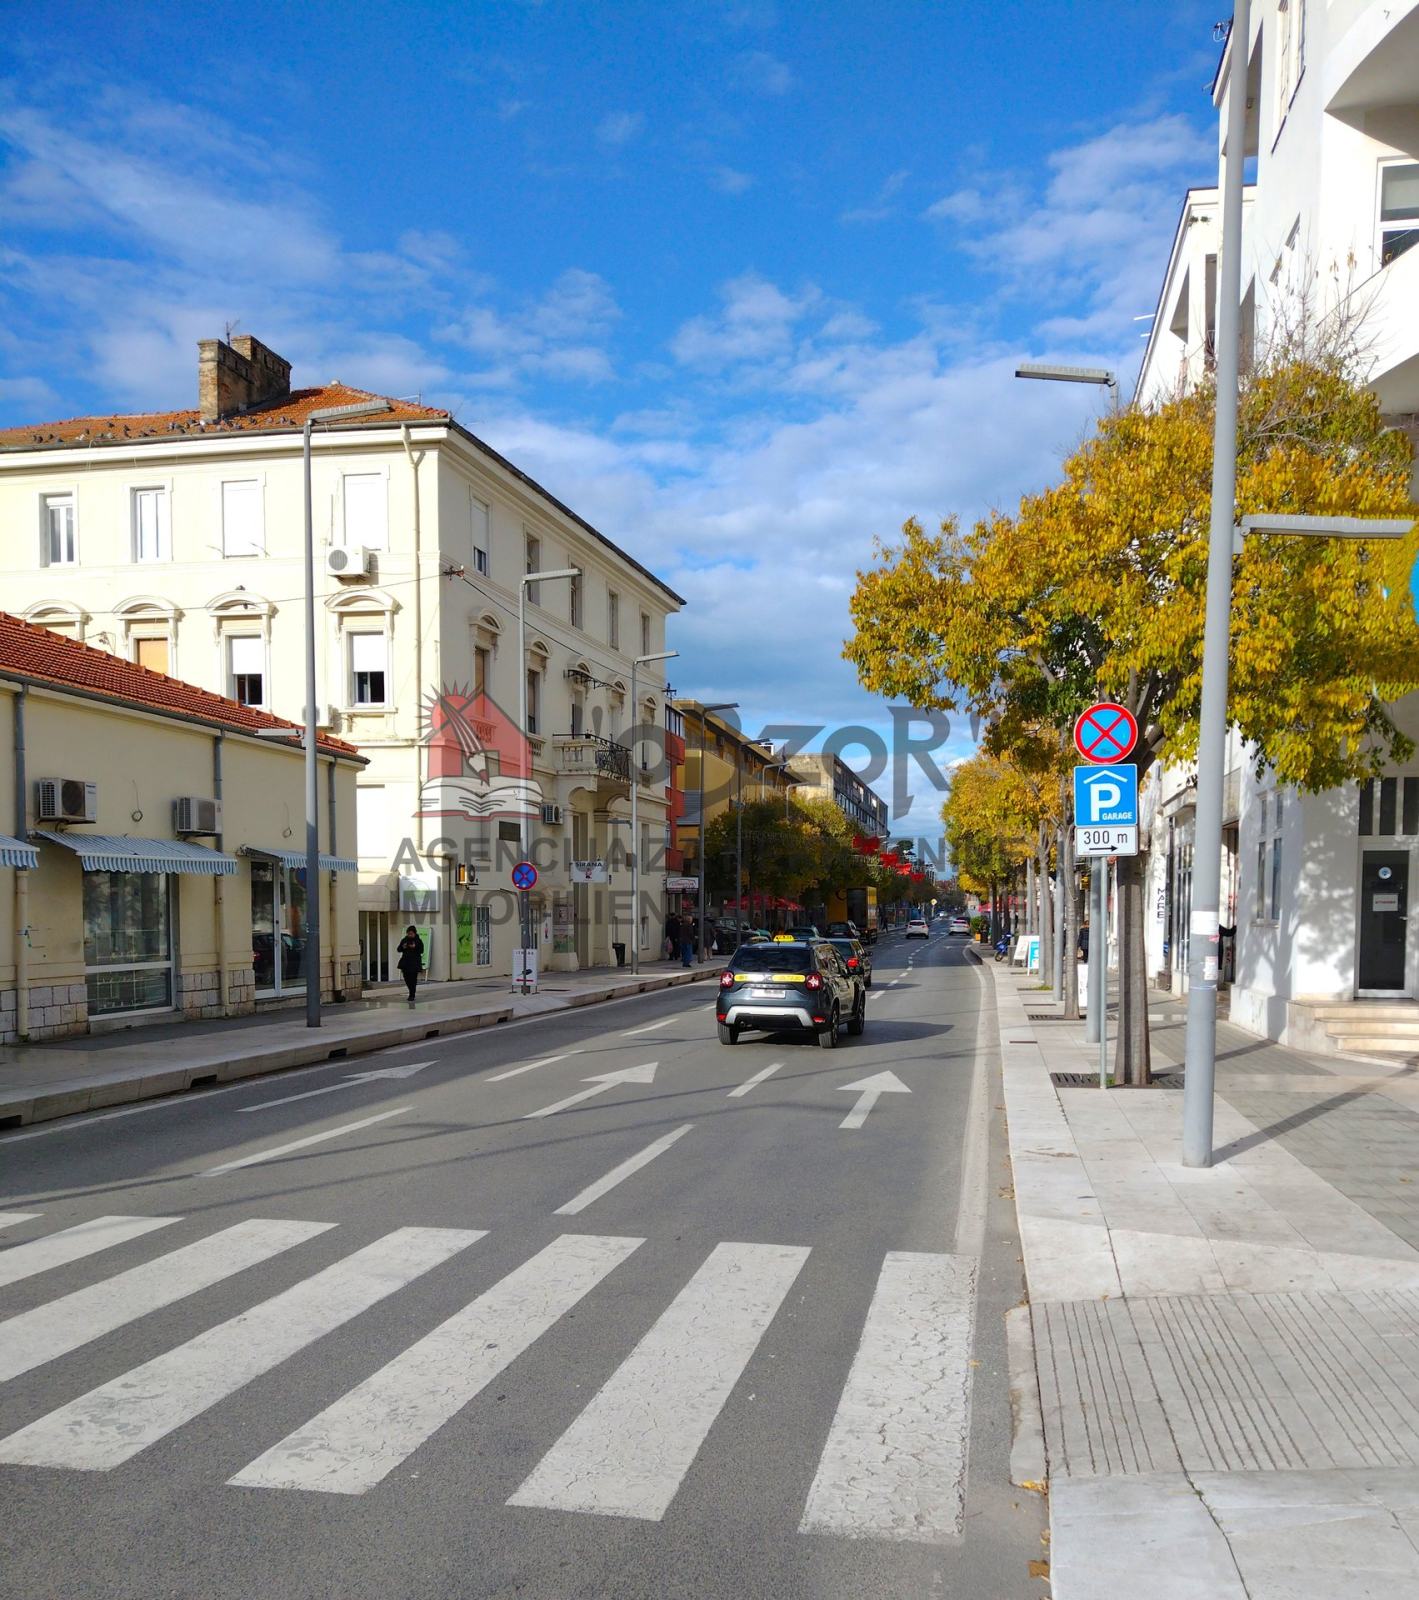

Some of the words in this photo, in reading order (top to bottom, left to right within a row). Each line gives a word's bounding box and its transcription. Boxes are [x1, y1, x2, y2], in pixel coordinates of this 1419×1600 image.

[1090, 783, 1121, 822] P
[1102, 812, 1132, 820] GARAGE
[1084, 831, 1110, 845] 300
[1117, 833, 1128, 844] m
